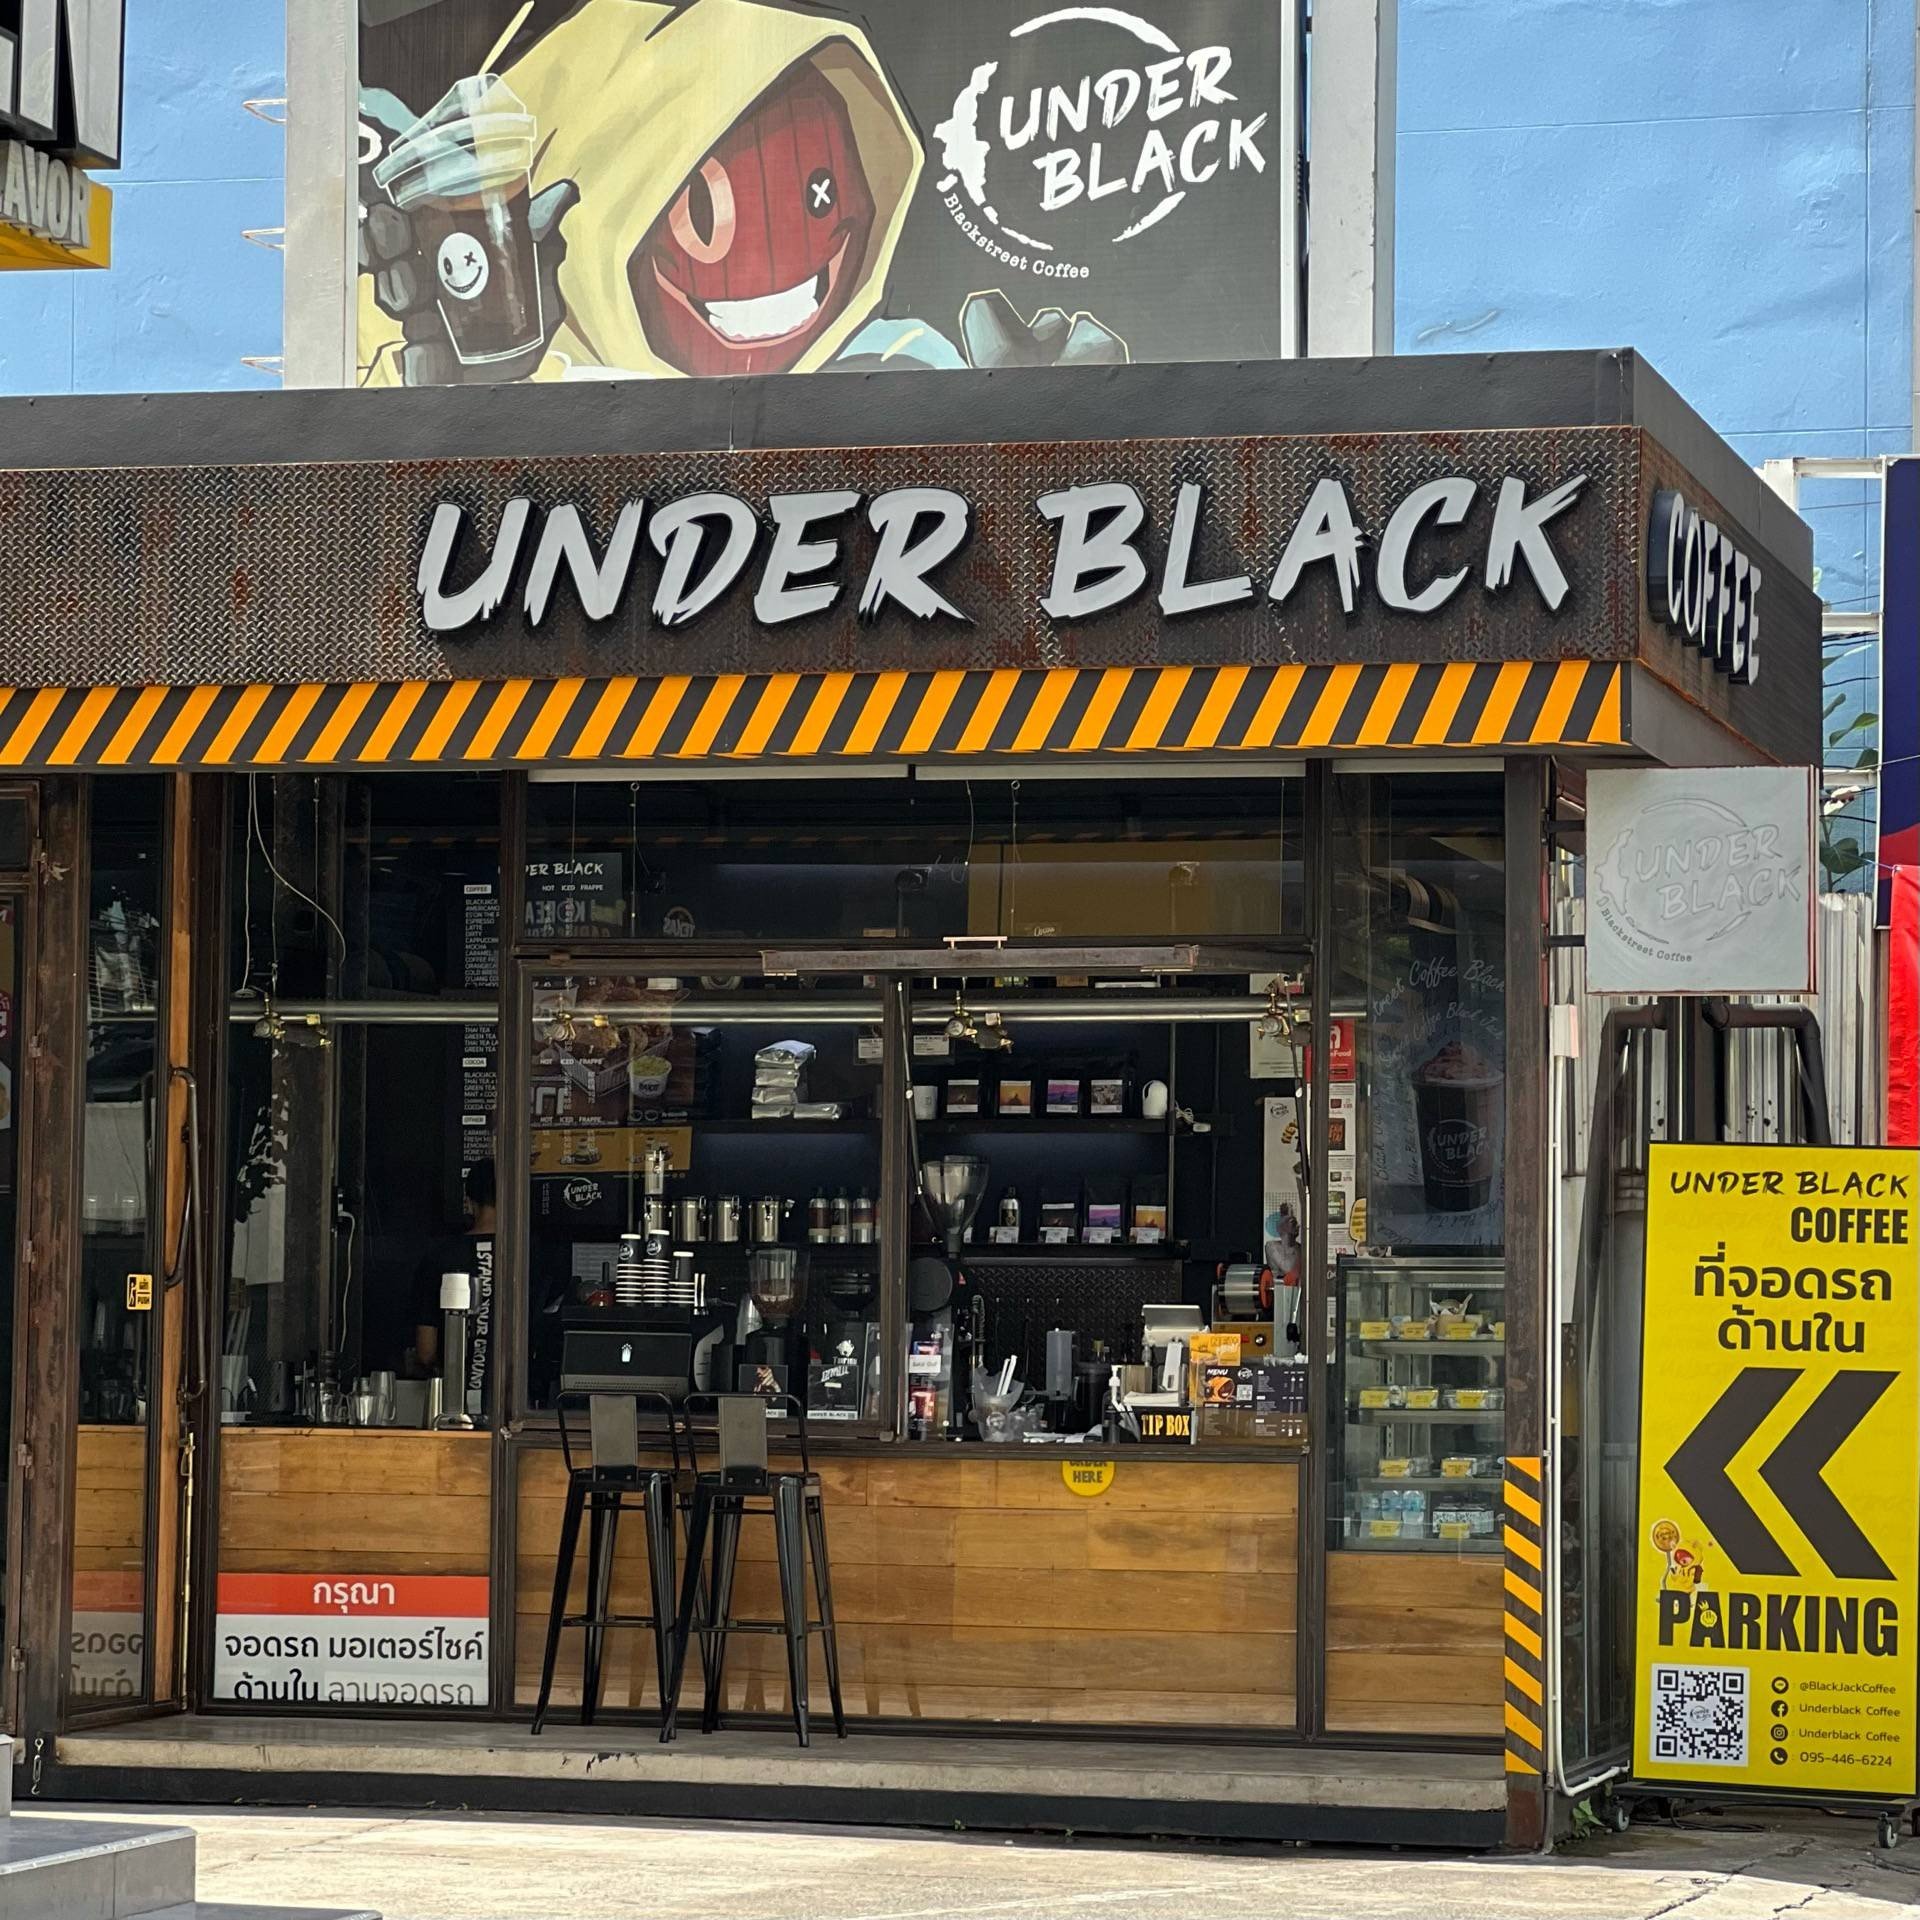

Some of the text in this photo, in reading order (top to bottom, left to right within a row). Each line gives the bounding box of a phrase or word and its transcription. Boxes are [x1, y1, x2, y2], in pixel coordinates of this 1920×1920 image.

[999, 45, 1239, 151] UNDER
[1033, 112, 1268, 211] BLACK
[0, 138, 90, 249] AVOR
[943, 193, 1090, 279] Blackstreet Coffee
[416, 471, 1590, 631] UNDER BLACK
[1667, 491, 1762, 687] COFFEE
[553, 863, 603, 876] BLACK
[1635, 824, 1782, 883] UNDER
[1657, 864, 1801, 921] BLACK
[1601, 908, 1692, 963] Blackstreet Coffee
[1409, 956, 1458, 989] Coffee
[1437, 1126, 1488, 1147] UNDER
[570, 1183, 599, 1194] UNDER
[575, 1191, 602, 1202] BLACK
[1670, 1171, 1910, 1200] UNDER BLACK
[1790, 1206, 1909, 1245] COFFEE
[1694, 1241, 1893, 1301] ที่จอดรถ
[1718, 1304, 1866, 1353] ด้านใน
[468, 1338, 487, 1390] GROUND
[1206, 1368, 1229, 1376] MENU
[1140, 1413, 1191, 1437] TIP BOX
[1072, 1470, 1104, 1484] HERE
[312, 1580, 396, 1613] กรุณา
[1658, 1590, 1899, 1657] PARKING
[225, 1626, 483, 1661] จอดรถ มอเตอร์ไซค์
[234, 1668, 319, 1701] ด้านใน
[1800, 1681, 1897, 1695] @BlackJackCoffee
[1799, 1704, 1900, 1717] Underblack Coffee
[1799, 1729, 1900, 1743] Underblack Coffee
[1800, 1752, 1893, 1767] 095-446-6224
